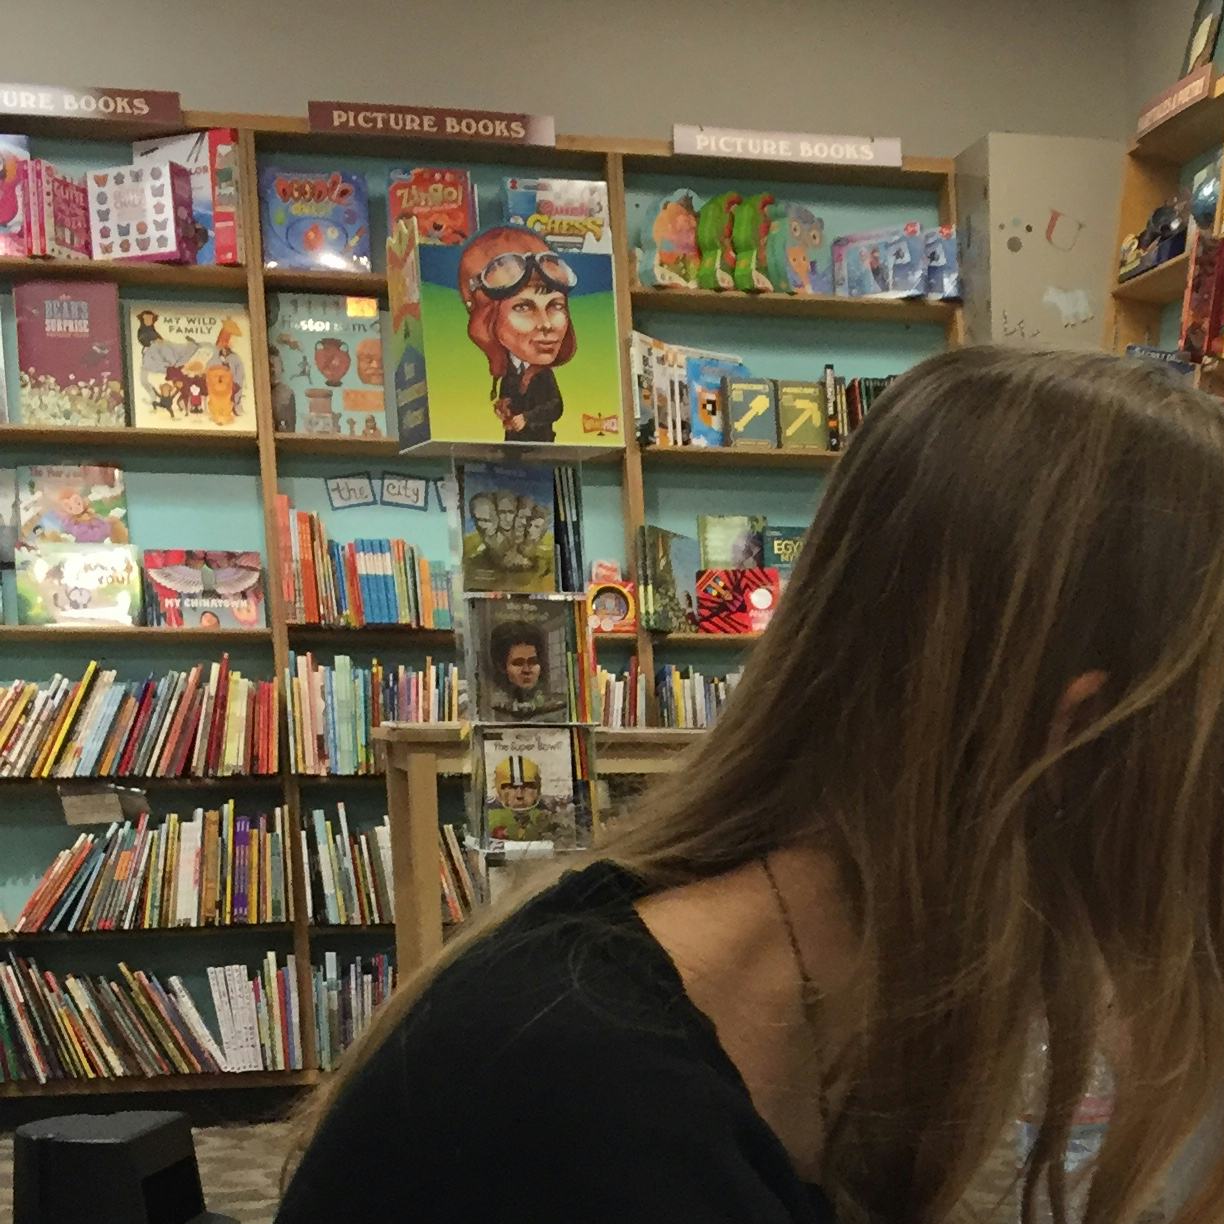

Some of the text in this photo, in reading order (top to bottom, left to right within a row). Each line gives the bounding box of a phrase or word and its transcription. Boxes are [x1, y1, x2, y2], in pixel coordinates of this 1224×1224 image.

[63, 94, 150, 115] BOOKS
[332, 110, 526, 139] PICTURE BOOKS
[695, 134, 875, 161] PICTURE BOOKS
[45, 319, 90, 333] SURPRISE
[163, 316, 217, 326] MY WILD
[168, 326, 214, 335] FAMILY
[331, 480, 420, 502] the city
[165, 597, 249, 609] MY CHINATOWN
